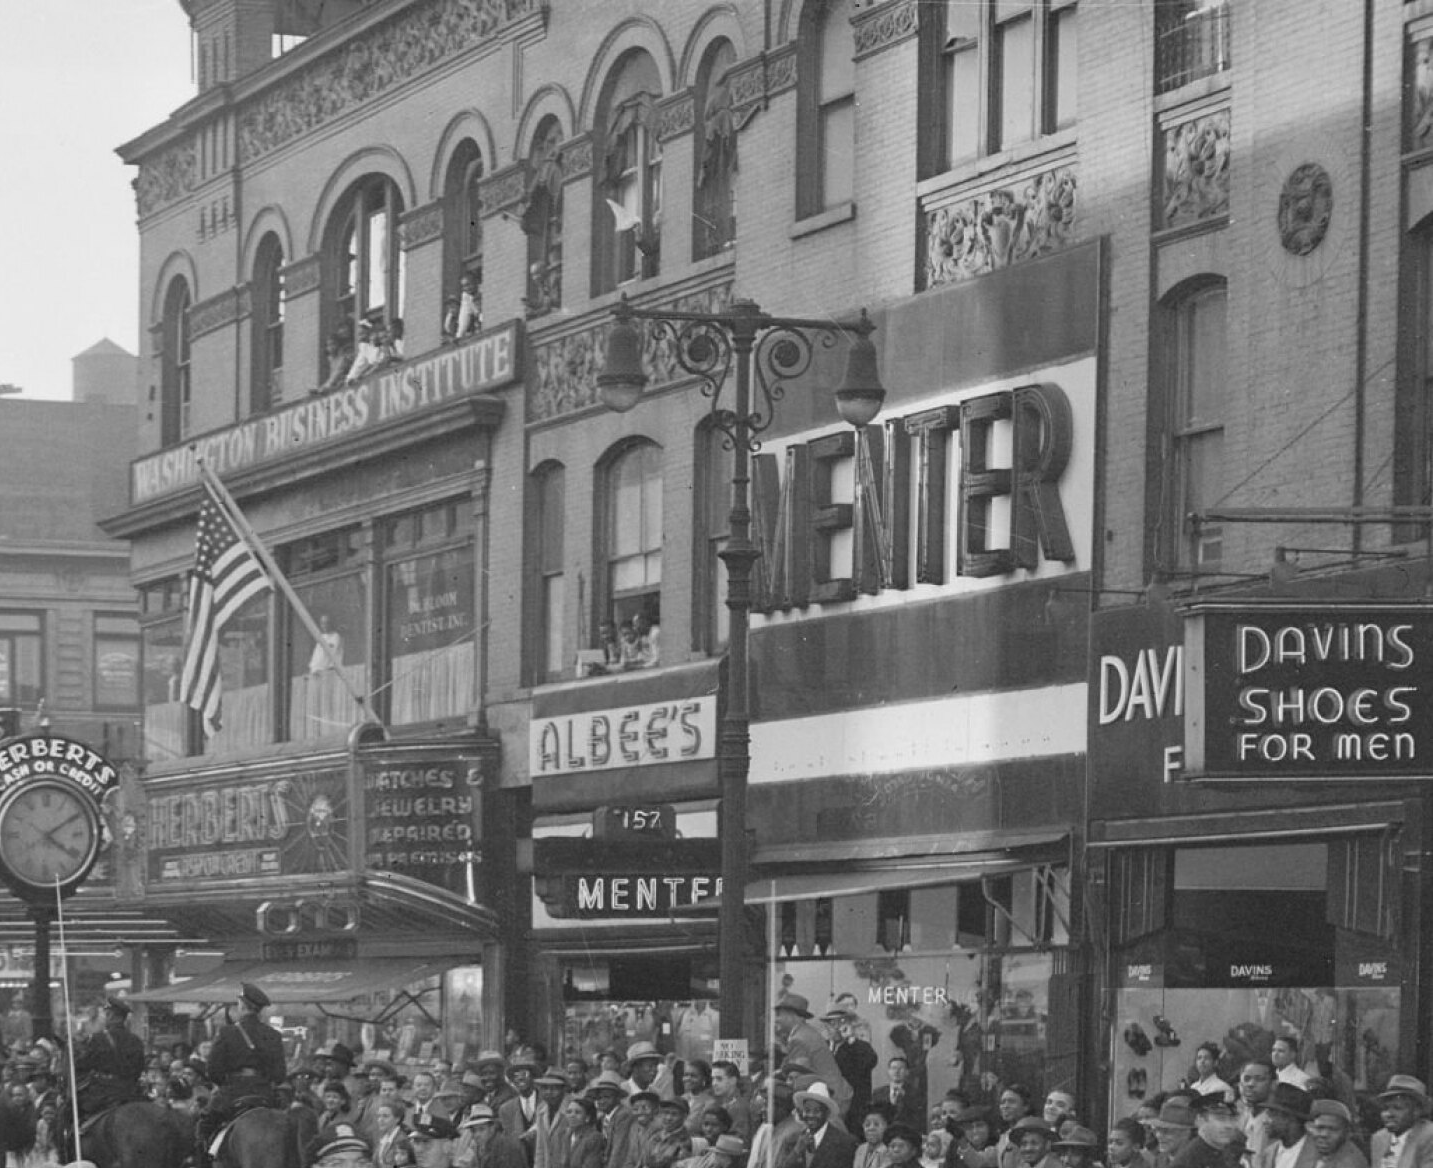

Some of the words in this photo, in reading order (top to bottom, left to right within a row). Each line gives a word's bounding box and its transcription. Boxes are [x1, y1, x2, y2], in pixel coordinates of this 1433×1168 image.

[134, 423, 258, 499] WASHINGTON
[266, 383, 369, 455] BUSINESS
[378, 330, 512, 421] INSTITUTE
[1238, 622, 1414, 674] DAVINS
[1099, 645, 1184, 725] DAVI
[1238, 686, 1418, 727] SHOES
[540, 702, 702, 772] ALBEE'S
[1238, 732, 1315, 761] FOR
[34, 760, 55, 772] OR
[59, 763, 103, 796] CREDIT
[466, 767, 484, 786] &
[368, 795, 473, 817] JEWELRY
[623, 810, 662, 830] 157
[1230, 964, 1273, 978] DAVINS
[868, 985, 948, 1005] MENTER
